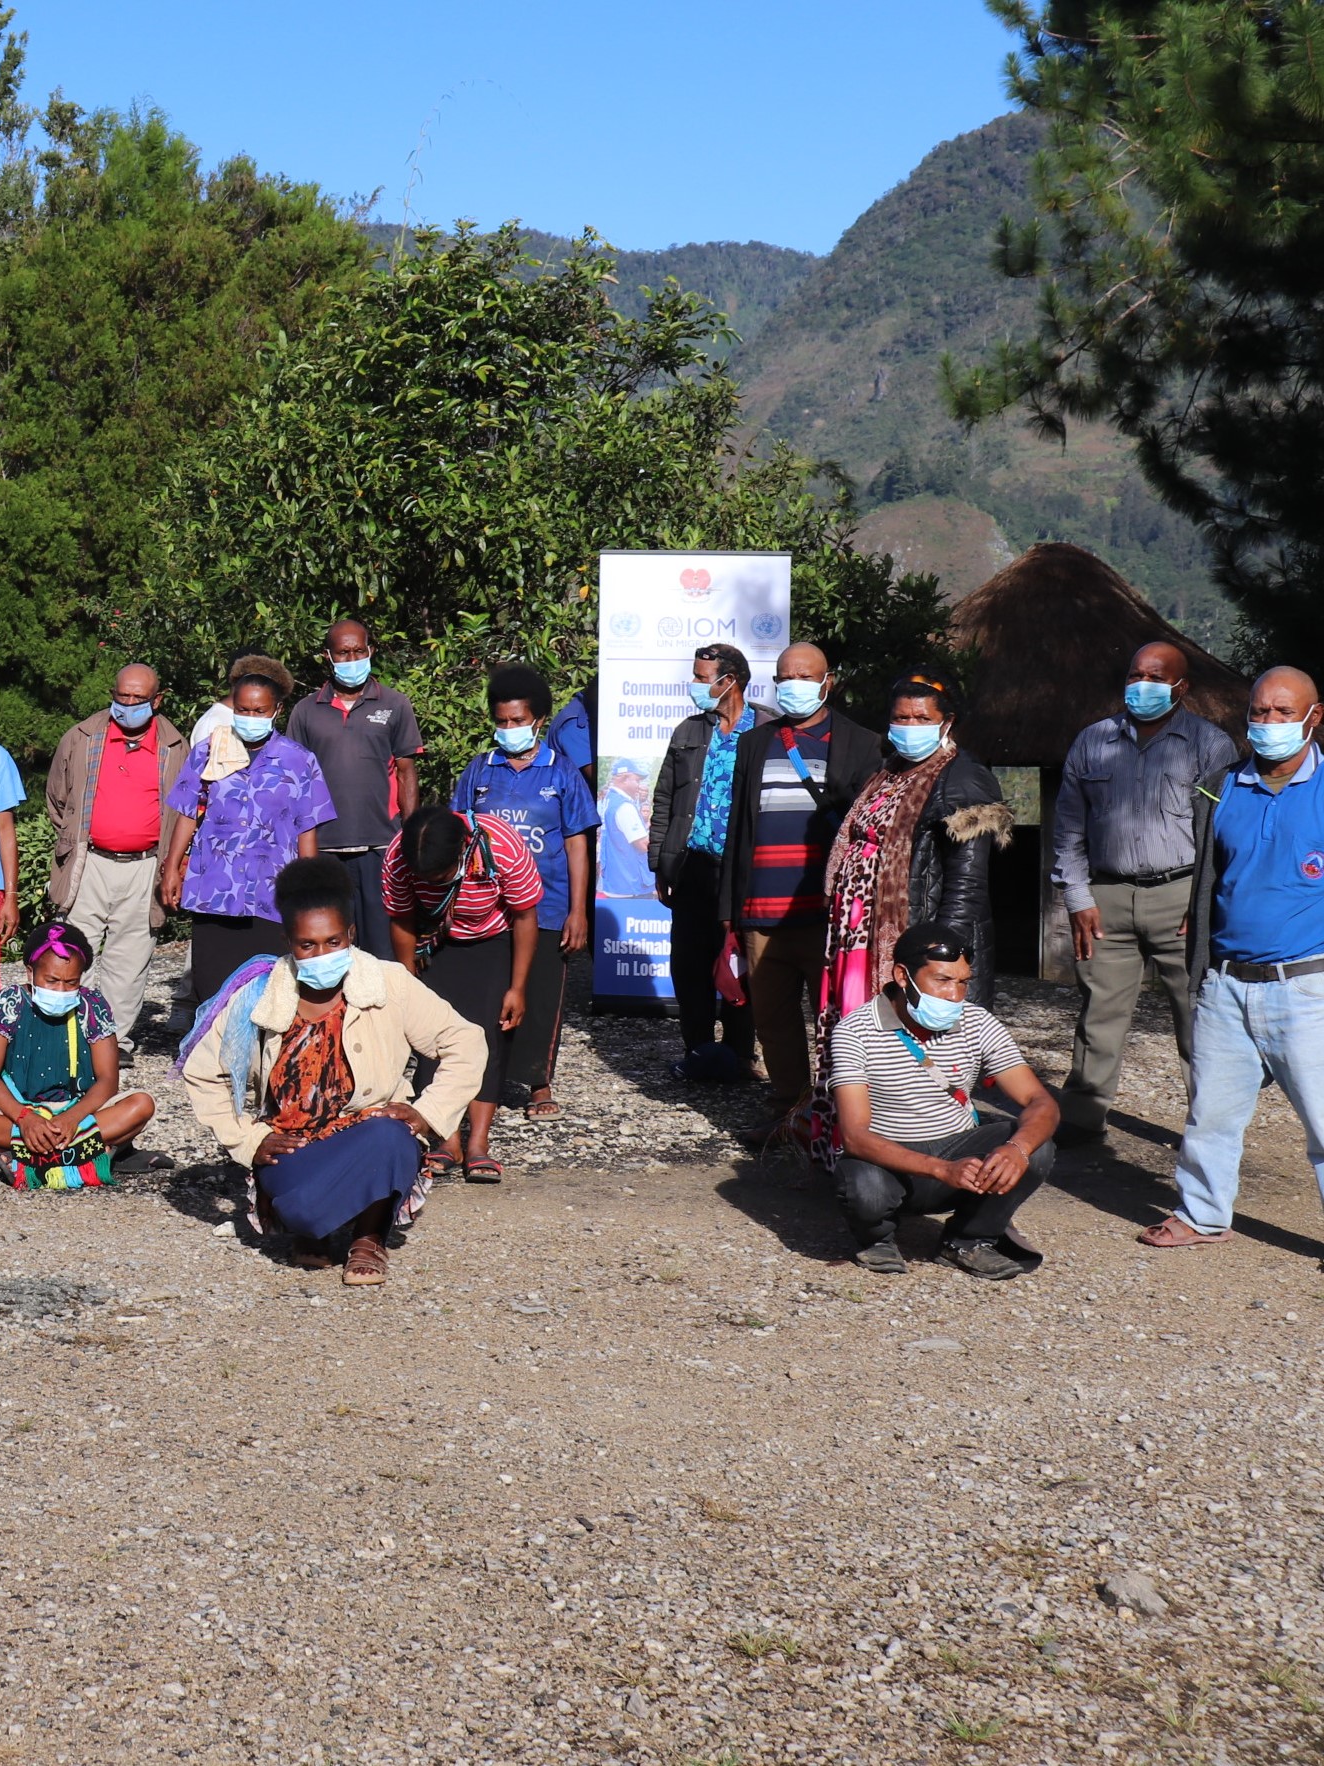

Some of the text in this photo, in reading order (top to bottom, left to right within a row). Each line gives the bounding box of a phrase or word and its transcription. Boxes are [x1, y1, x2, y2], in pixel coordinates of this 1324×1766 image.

[687, 617, 736, 638] IOM
[656, 639, 673, 648] UN
[622, 680, 692, 697] Communit
[627, 724, 653, 740] and
[489, 808, 528, 823] NSW
[626, 916, 673, 934] Promo
[603, 938, 672, 956] Sustainab
[616, 959, 670, 978] in Local
